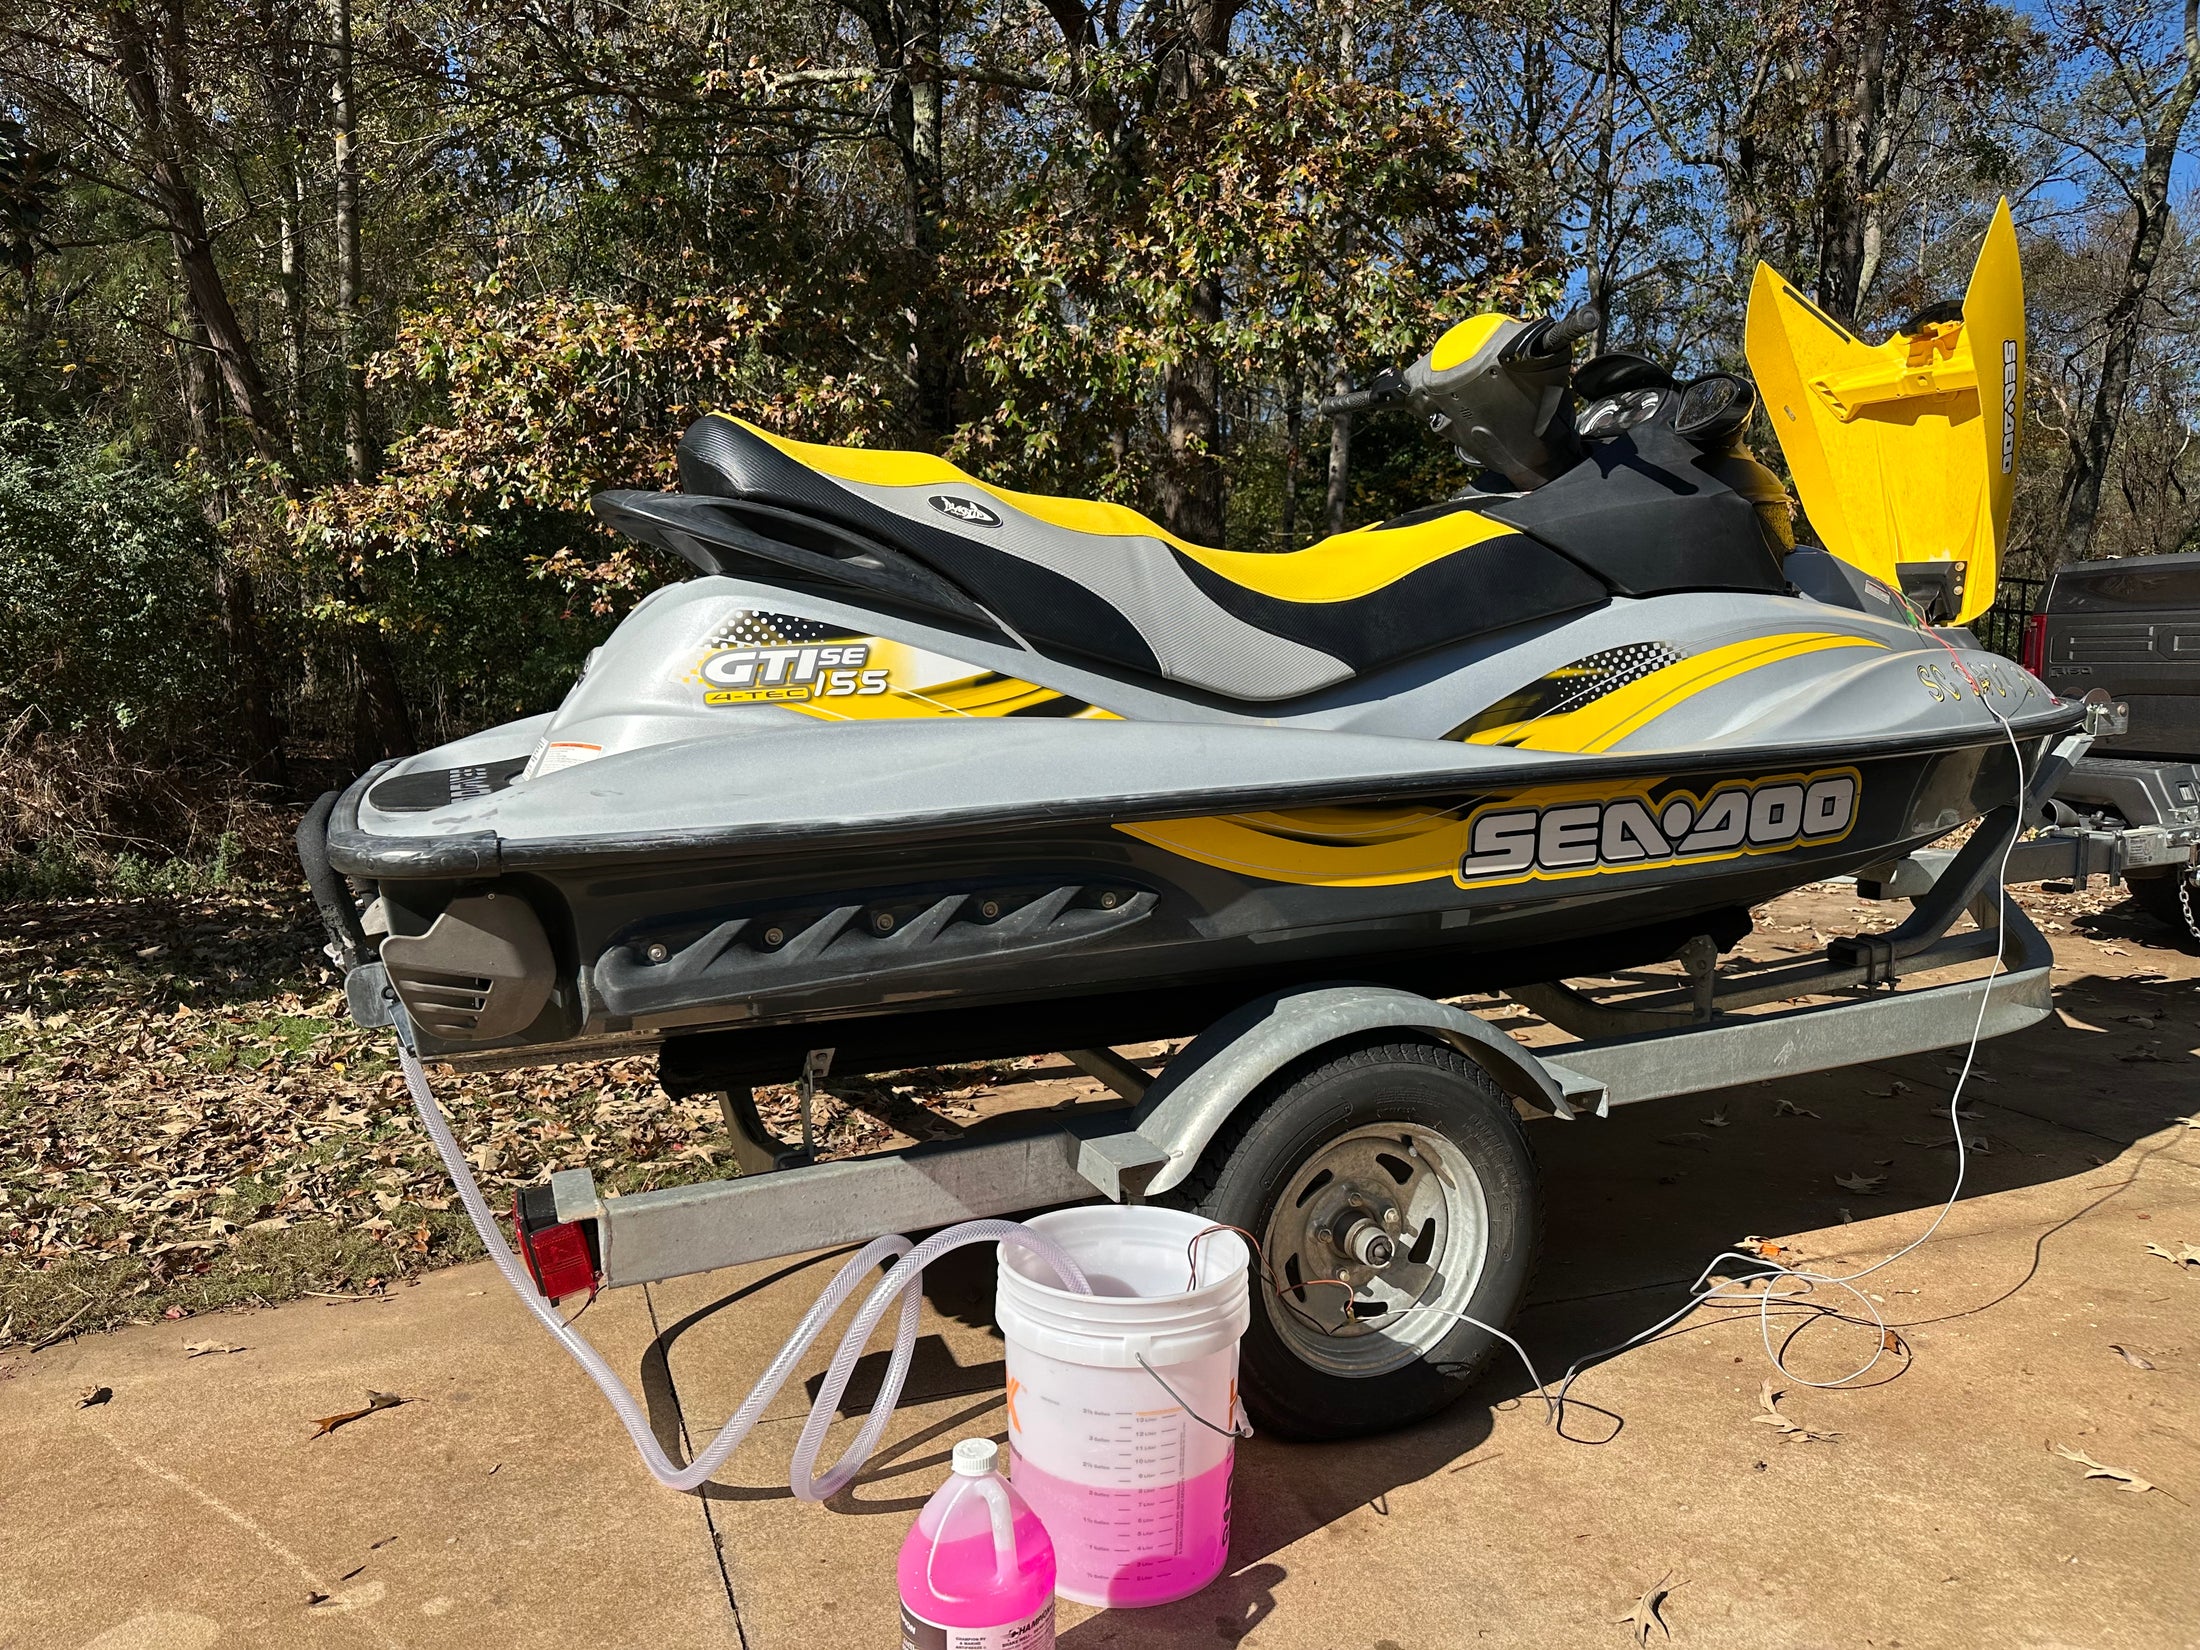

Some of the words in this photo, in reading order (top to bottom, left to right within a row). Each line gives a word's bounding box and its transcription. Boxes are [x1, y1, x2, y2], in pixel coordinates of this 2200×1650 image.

[704, 648, 820, 684] GTI
[818, 647, 868, 666] SE
[710, 687, 806, 702] 4-TEC
[814, 669, 889, 697] 155
